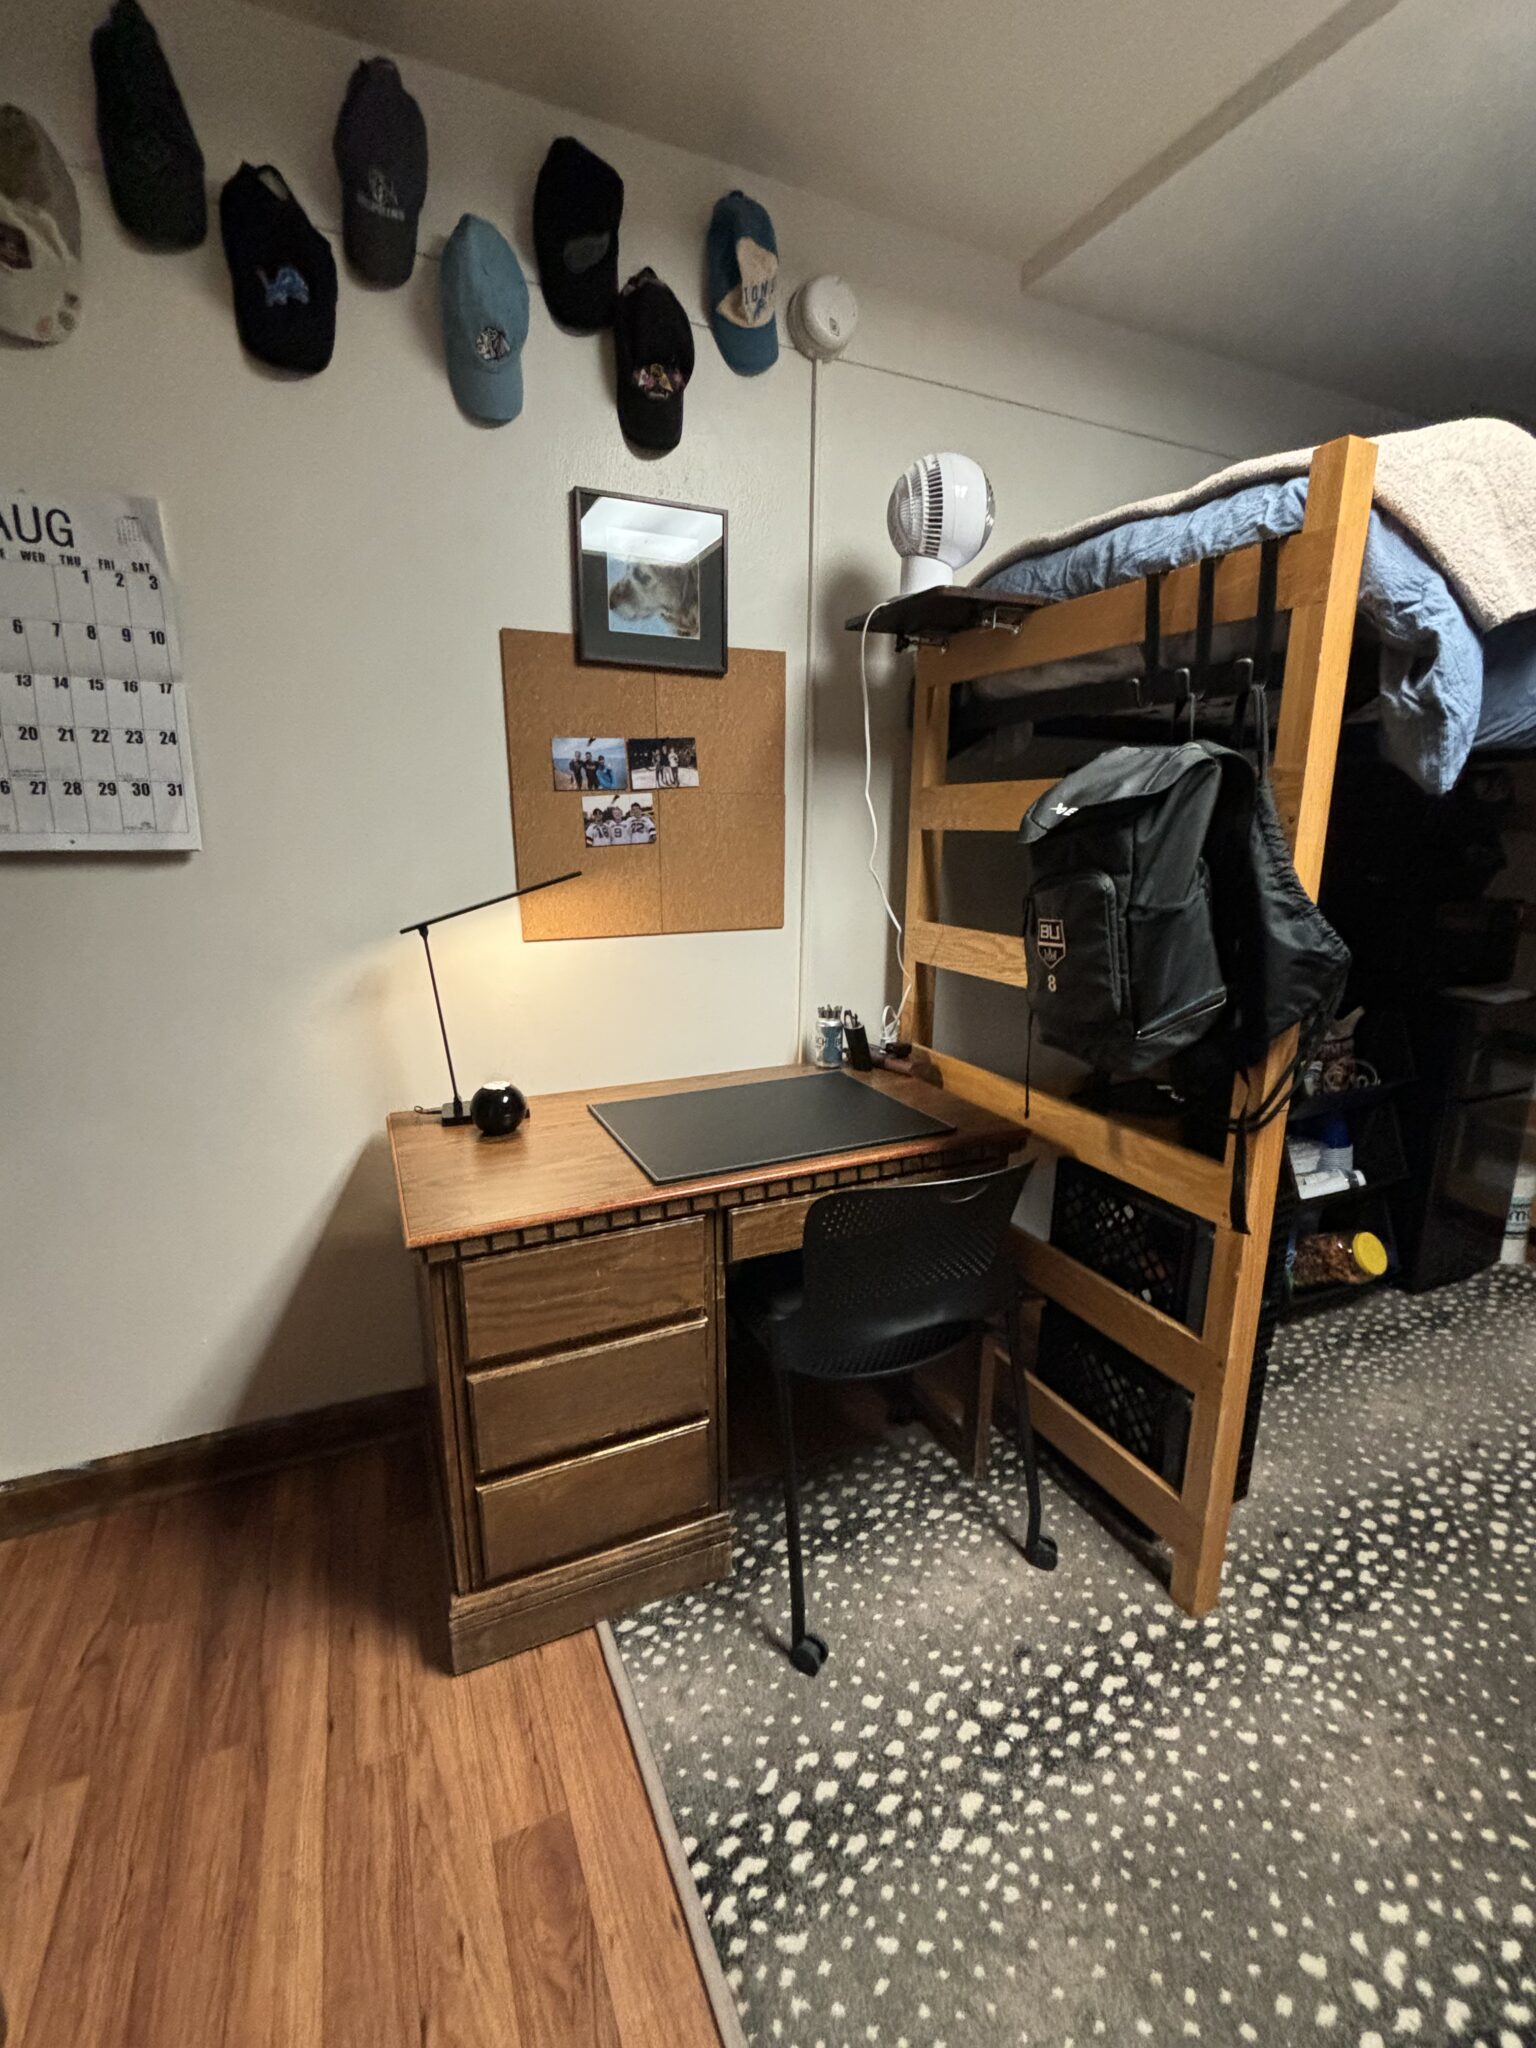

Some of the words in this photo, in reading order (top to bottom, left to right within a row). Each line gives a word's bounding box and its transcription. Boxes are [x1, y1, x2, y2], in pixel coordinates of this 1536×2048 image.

[20, 550, 46, 563] WED
[59, 554, 82, 568] THU
[98, 558, 115, 571] FRI
[131, 561, 151, 574] SAT
[82, 569, 90, 585] 1
[115, 573, 125, 588] 2
[149, 575, 159, 590] 3
[12, 619, 24, 634] 6
[51, 622, 61, 637] 7
[86, 625, 97, 640] 8
[121, 628, 132, 642] 9
[150, 631, 166, 645] 10
[15, 674, 32, 687] 13
[53, 676, 69, 690] 14
[88, 678, 105, 691] 15
[123, 680, 139, 693] 16
[159, 682, 173, 694] 17
[18, 726, 39, 741] 20
[57, 727, 75, 742] 21
[91, 729, 110, 743] 22
[125, 730, 144, 744] 23
[159, 731, 178, 746] 24
[0, 780, 11, 794] 6
[29, 781, 47, 795] 27
[63, 781, 83, 796] 28
[98, 782, 118, 796] 29
[132, 782, 151, 797] 30
[167, 783, 184, 796] 31
[1047, 974, 1057, 992] 8
